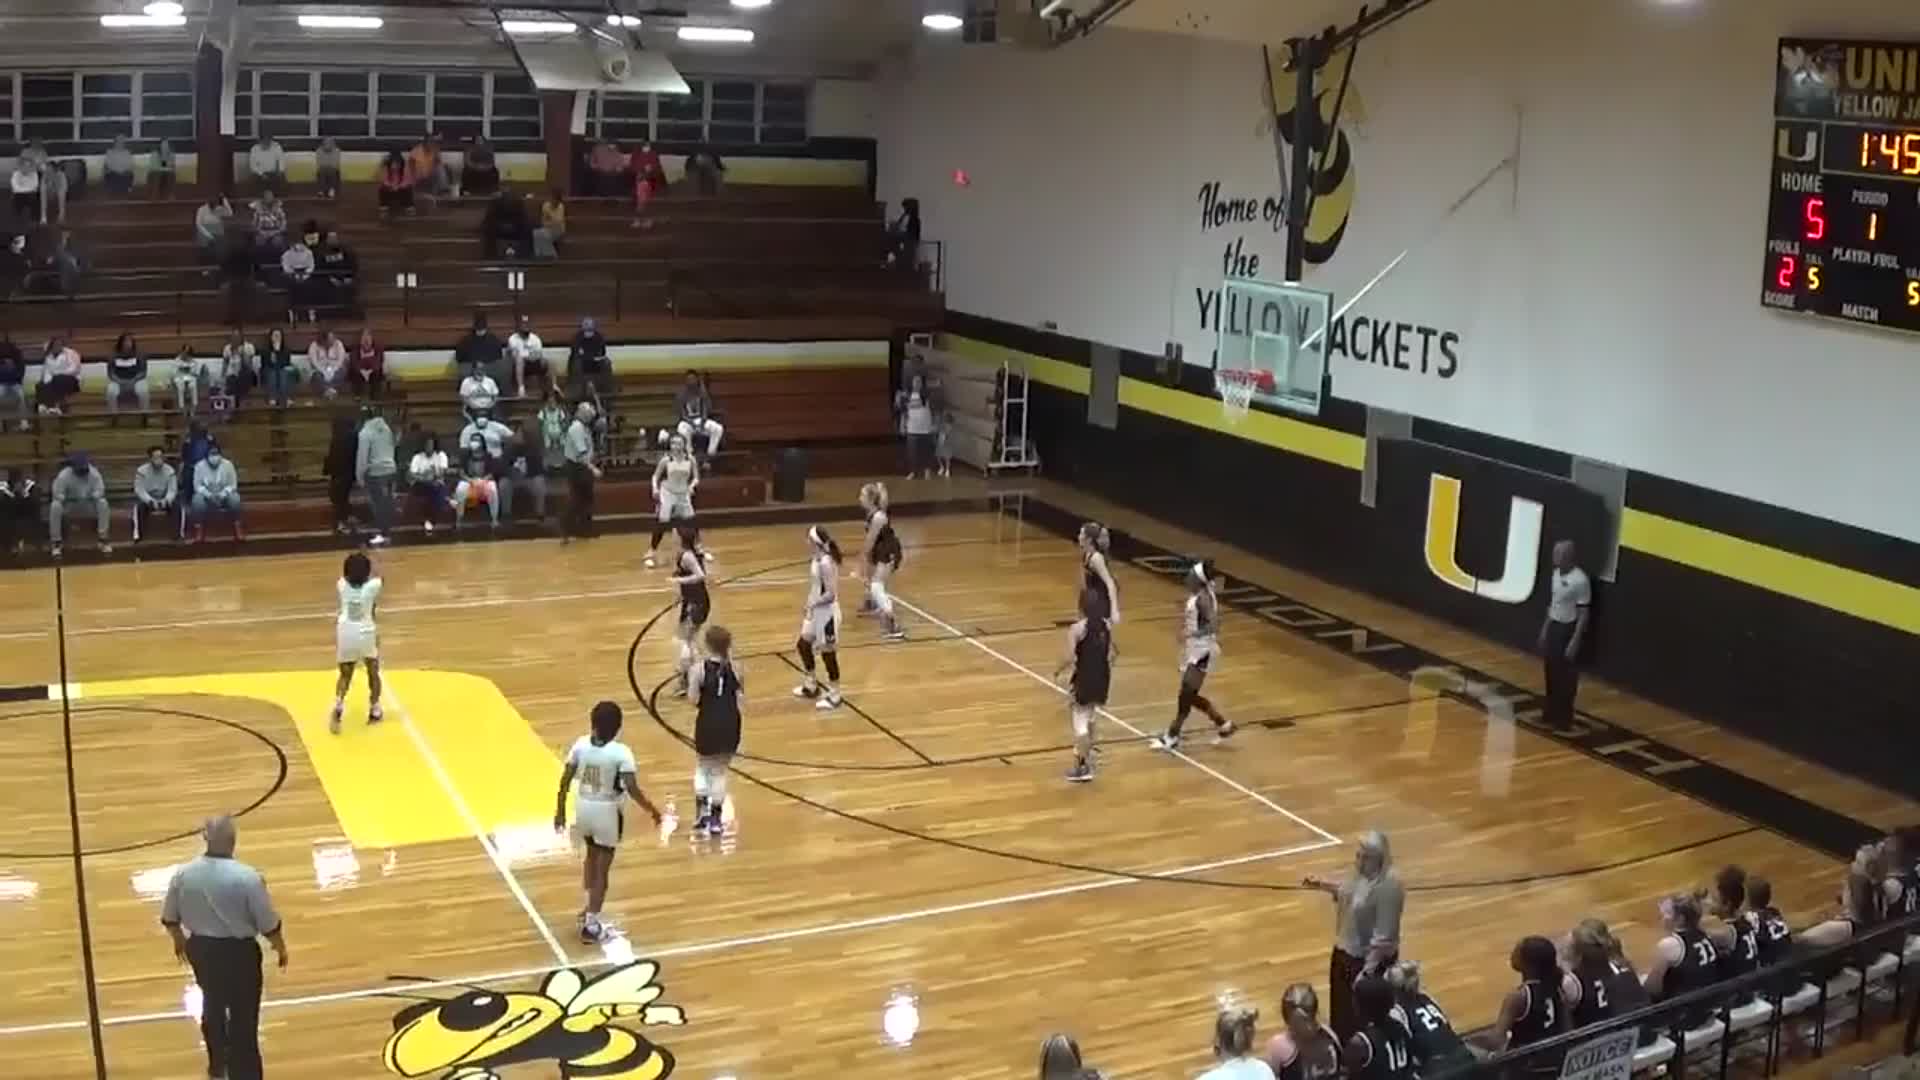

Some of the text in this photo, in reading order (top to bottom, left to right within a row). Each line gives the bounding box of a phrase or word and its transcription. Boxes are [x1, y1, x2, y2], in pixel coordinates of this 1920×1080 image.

[1845, 46, 1918, 92] UNI
[1833, 94, 1899, 118] YELLOW
[1778, 127, 1817, 162] U
[1781, 172, 1823, 193] HOME
[1197, 181, 1258, 231] Home
[1851, 189, 1889, 207] PERIOD
[1806, 199, 1824, 239] 5
[1869, 212, 1877, 240] 1
[1224, 237, 1259, 277] the
[1832, 247, 1872, 265] PLAYER
[1779, 256, 1795, 287] 2
[1808, 266, 1819, 290] 5
[1764, 291, 1796, 308] SCORE
[1907, 280, 1919, 306] 5
[1841, 303, 1879, 321] MATCH
[1308, 313, 1460, 379] ACKETS
[1424, 472, 1544, 604] U
[716, 676, 723, 697] 1
[1693, 936, 1716, 967] 33
[1593, 980, 1609, 1009] 2
[1543, 997, 1555, 1029] 3
[1385, 1040, 1408, 1072] 10
